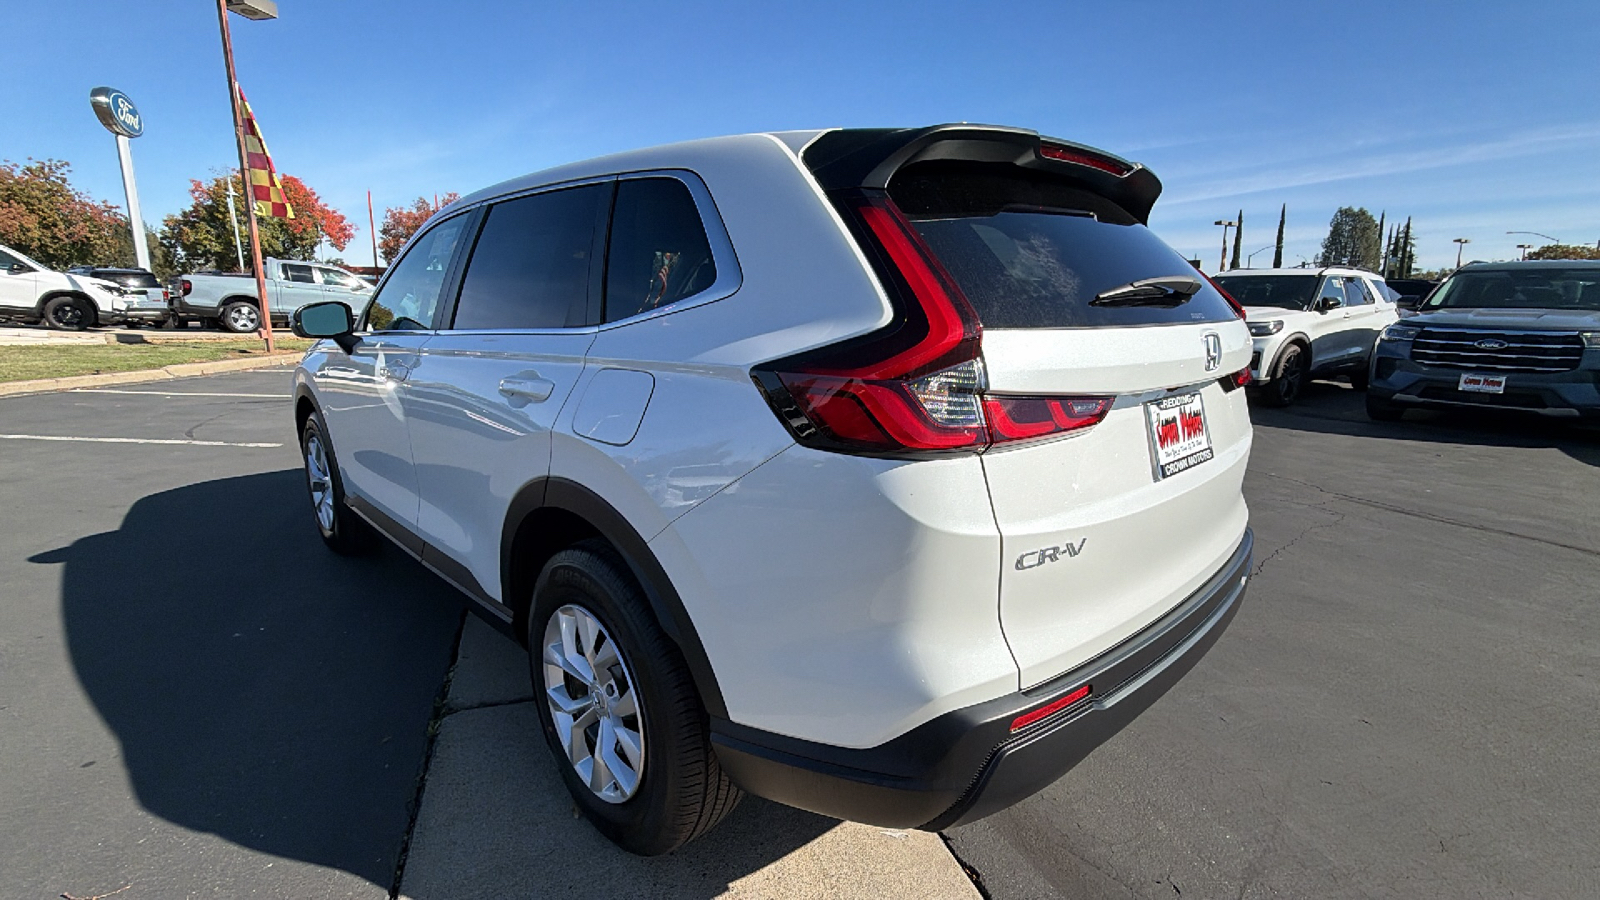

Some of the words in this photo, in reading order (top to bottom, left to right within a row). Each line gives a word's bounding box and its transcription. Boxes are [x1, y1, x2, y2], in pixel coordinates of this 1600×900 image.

[117, 97, 139, 130] Ford
[1165, 457, 1189, 475] CROWN
[1188, 450, 1212, 467] MOTORS
[1015, 537, 1087, 571] CR-V
